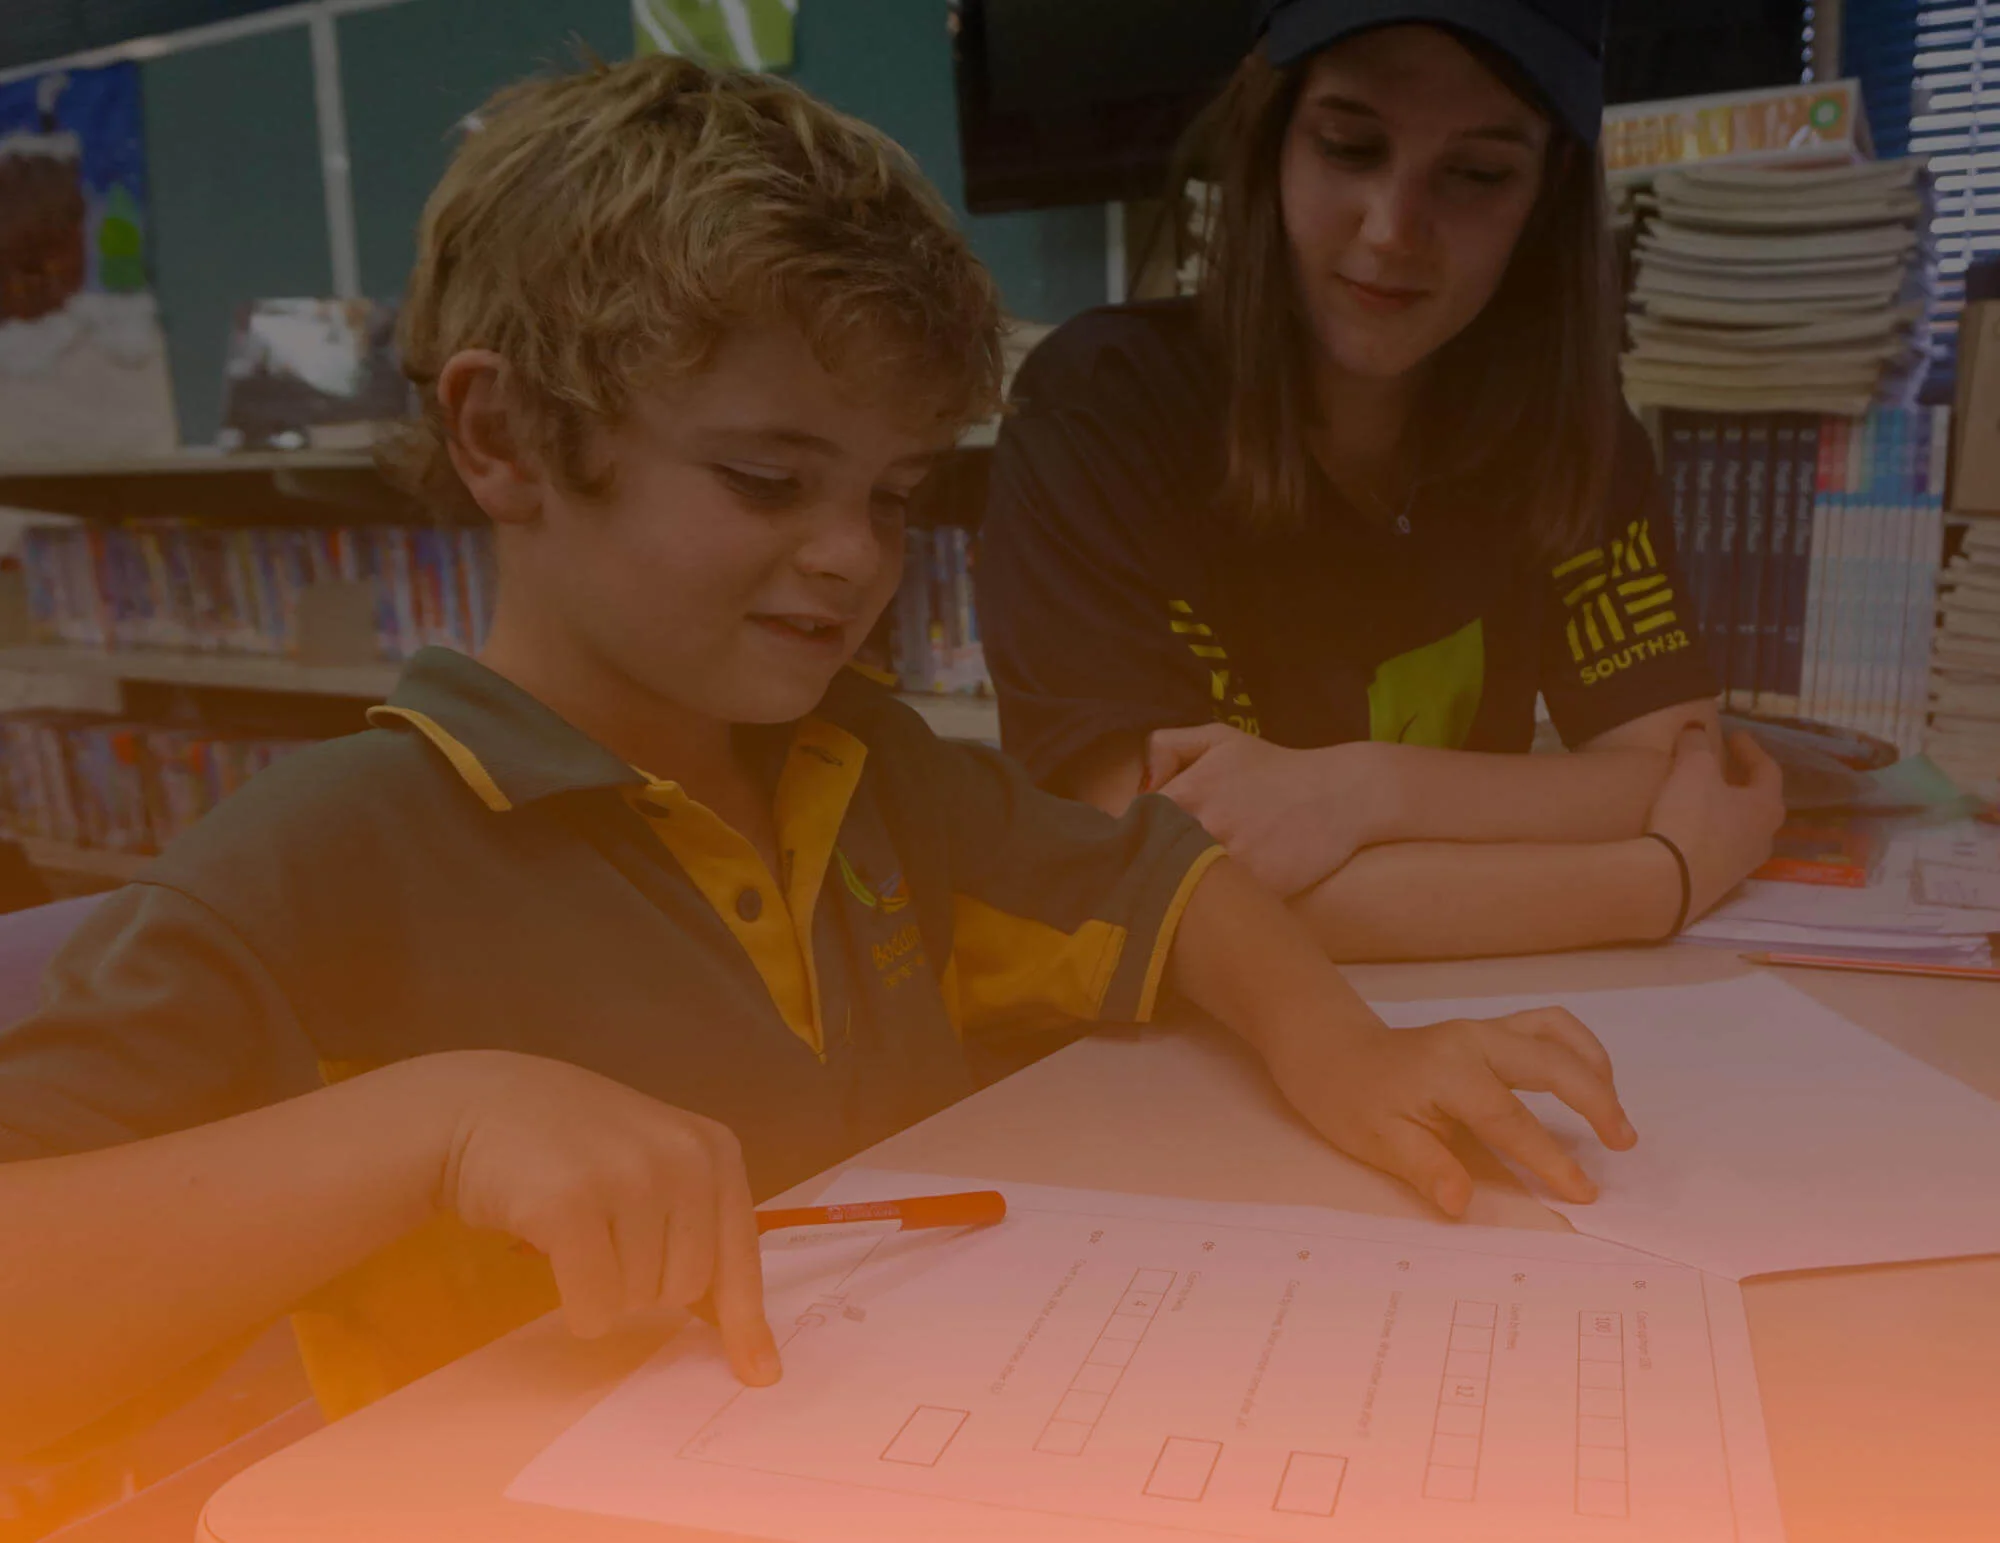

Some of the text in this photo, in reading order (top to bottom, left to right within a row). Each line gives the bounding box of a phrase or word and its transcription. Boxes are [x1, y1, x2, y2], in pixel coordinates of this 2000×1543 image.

[1580, 629, 1690, 686] SOUTH32
[1595, 1315, 1611, 1334] 100
[1455, 1384, 1475, 1398] 12
